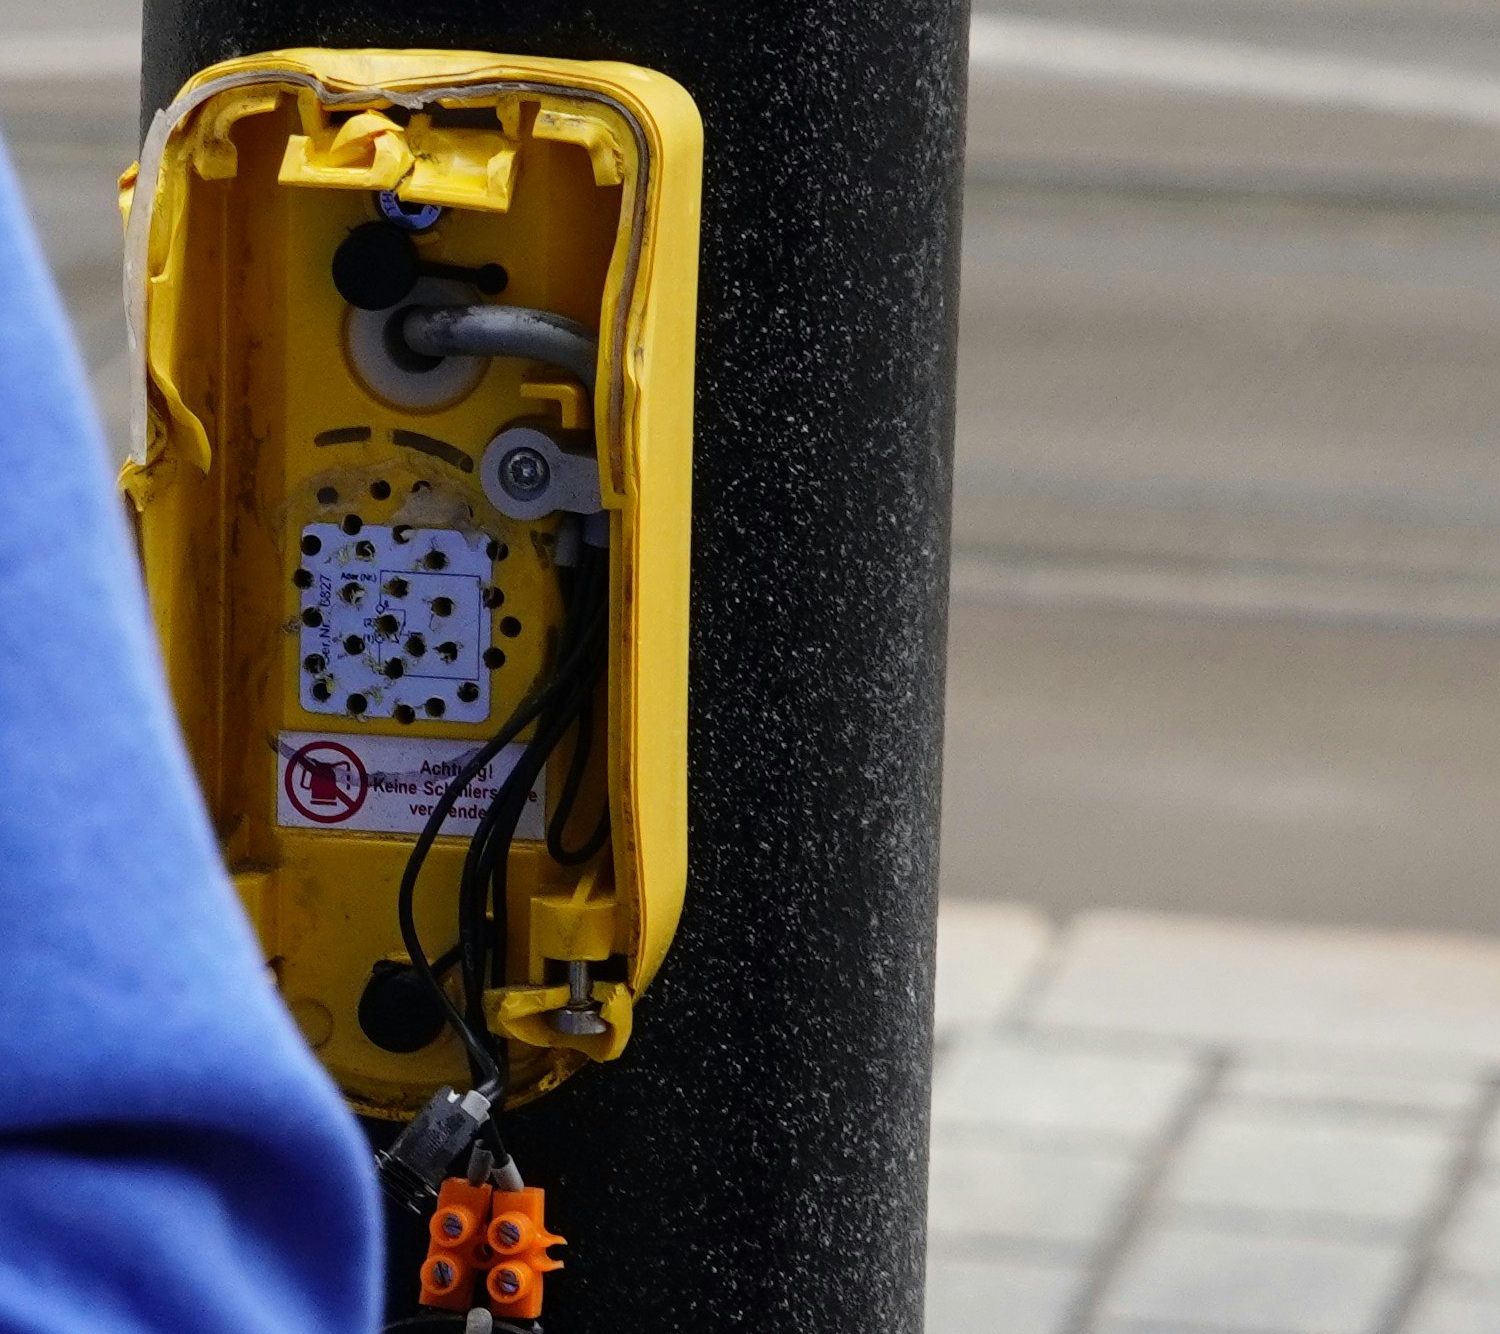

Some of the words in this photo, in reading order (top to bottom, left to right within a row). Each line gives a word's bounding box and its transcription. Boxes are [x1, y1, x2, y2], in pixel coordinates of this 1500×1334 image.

[420, 760, 493, 780] Achtg!
[374, 777, 417, 794] Keine
[409, 803, 488, 819] verende
